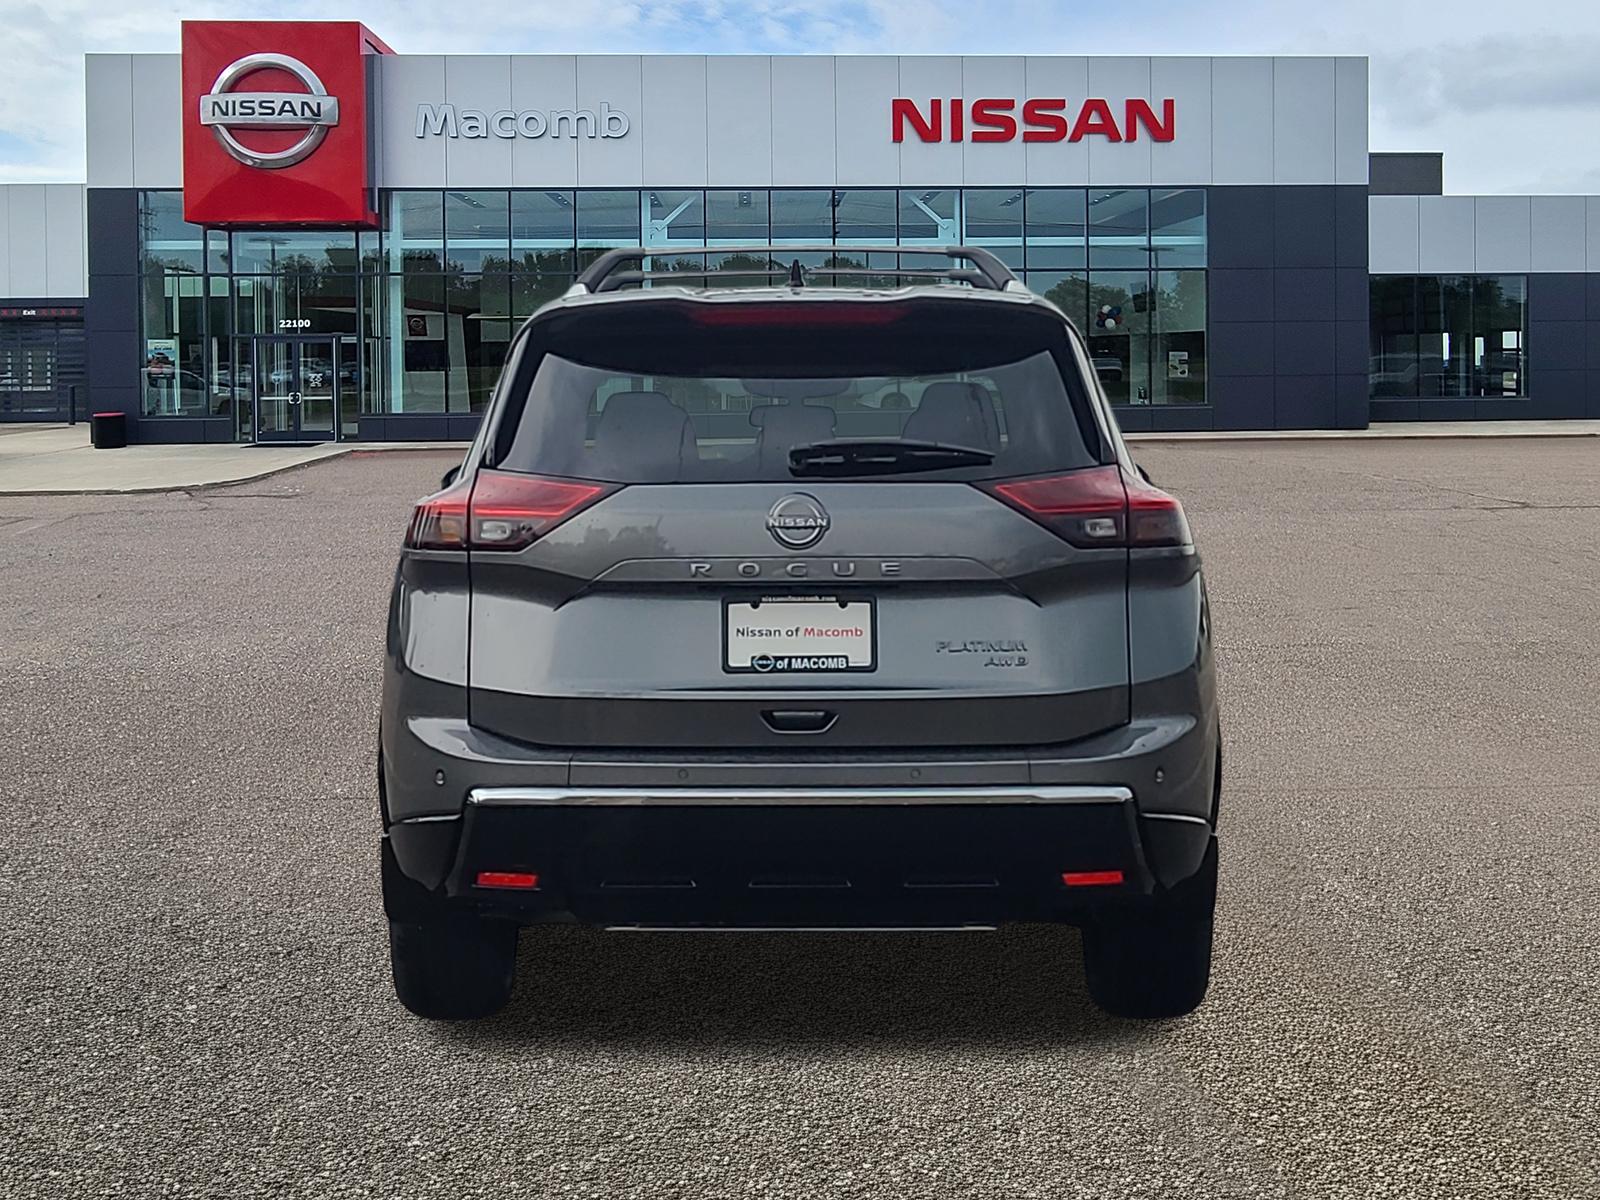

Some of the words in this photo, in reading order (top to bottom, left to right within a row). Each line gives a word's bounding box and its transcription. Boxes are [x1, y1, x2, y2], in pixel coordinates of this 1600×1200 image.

[211, 99, 322, 118] NISSAN
[415, 102, 630, 139] Macomb
[892, 98, 1175, 143] NISSAN
[279, 319, 311, 328] 22100
[768, 518, 827, 528] NISSAN
[690, 563, 901, 577] ROGUE
[736, 627, 781, 638] Nissan
[785, 627, 800, 638] of
[803, 627, 864, 638] Macomb
[936, 640, 1028, 653] PLATINUM
[776, 658, 788, 669] of
[791, 658, 847, 669] MACOMB
